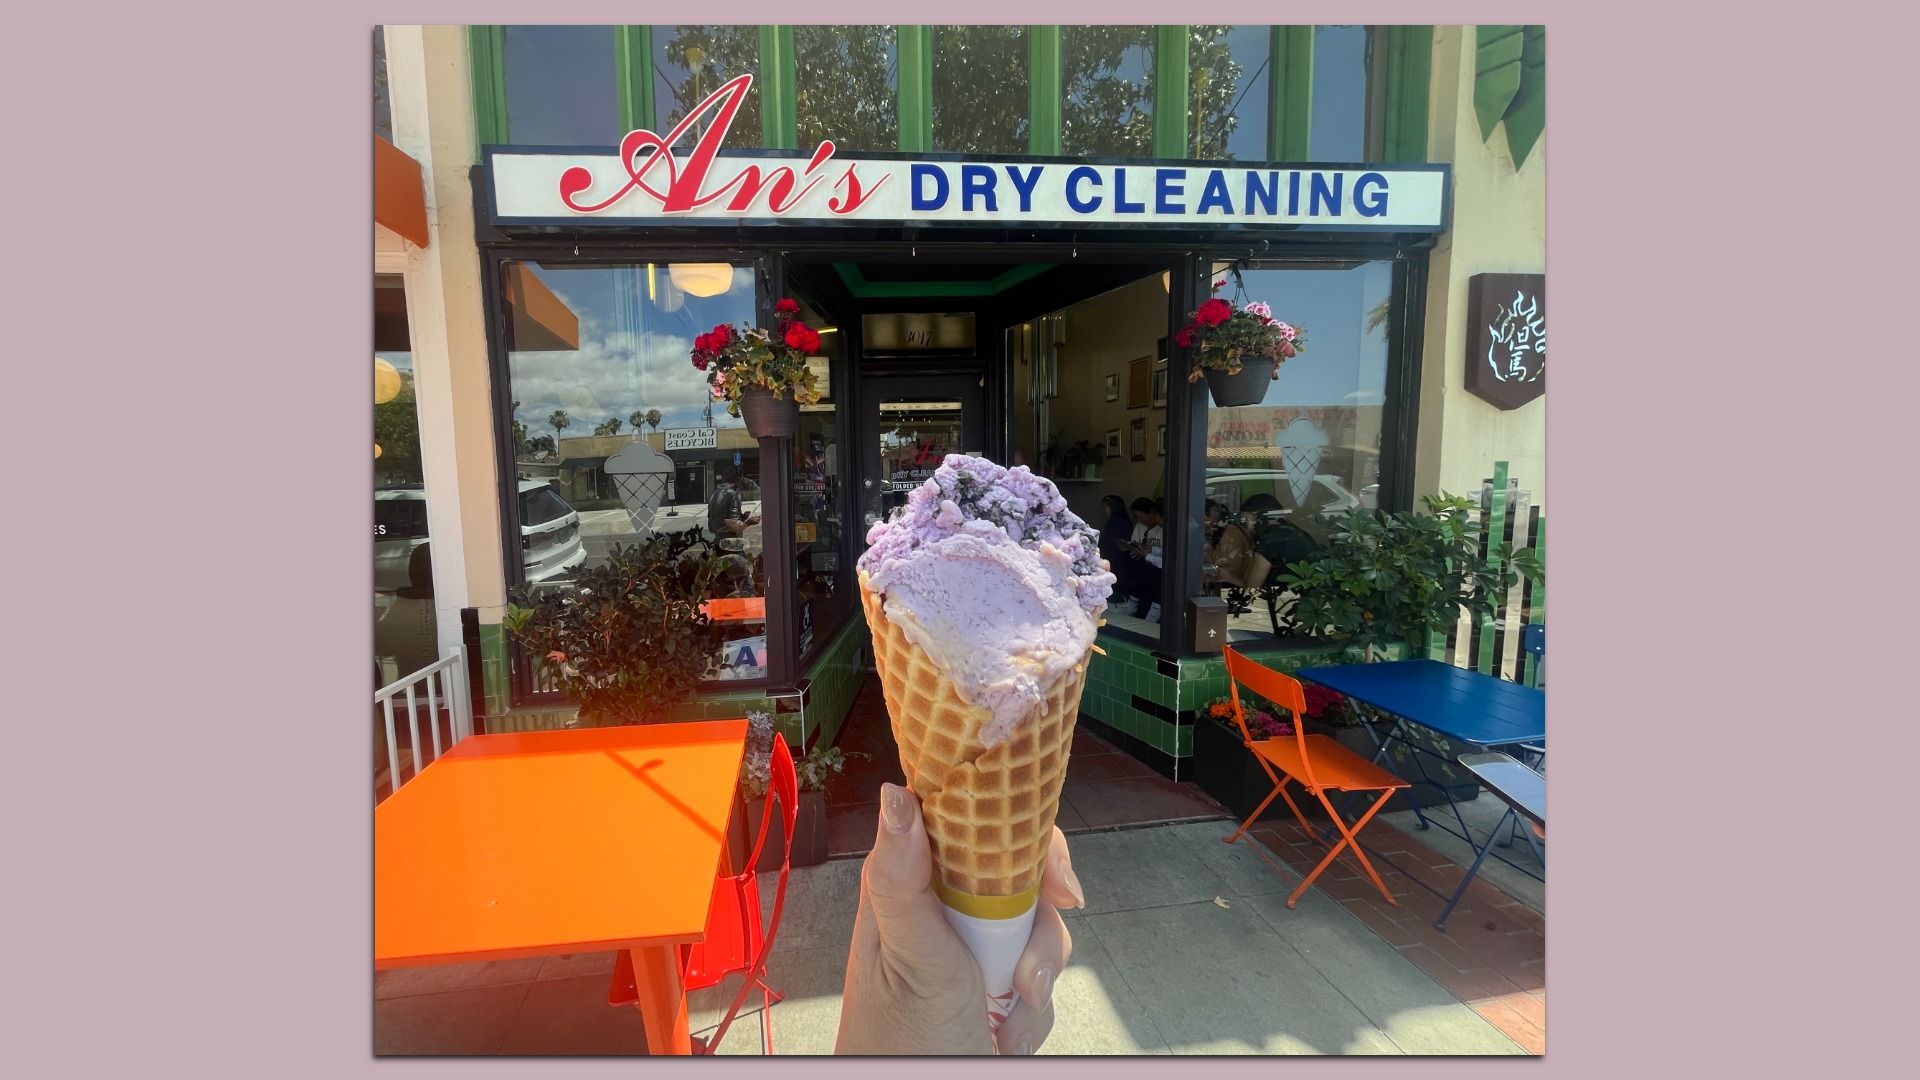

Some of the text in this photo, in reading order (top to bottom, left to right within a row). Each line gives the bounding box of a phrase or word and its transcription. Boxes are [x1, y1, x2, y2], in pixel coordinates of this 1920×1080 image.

[559, 74, 1390, 219] An's DRY CLEANING
[910, 469, 936, 478] CLEA
[734, 645, 758, 667] A
